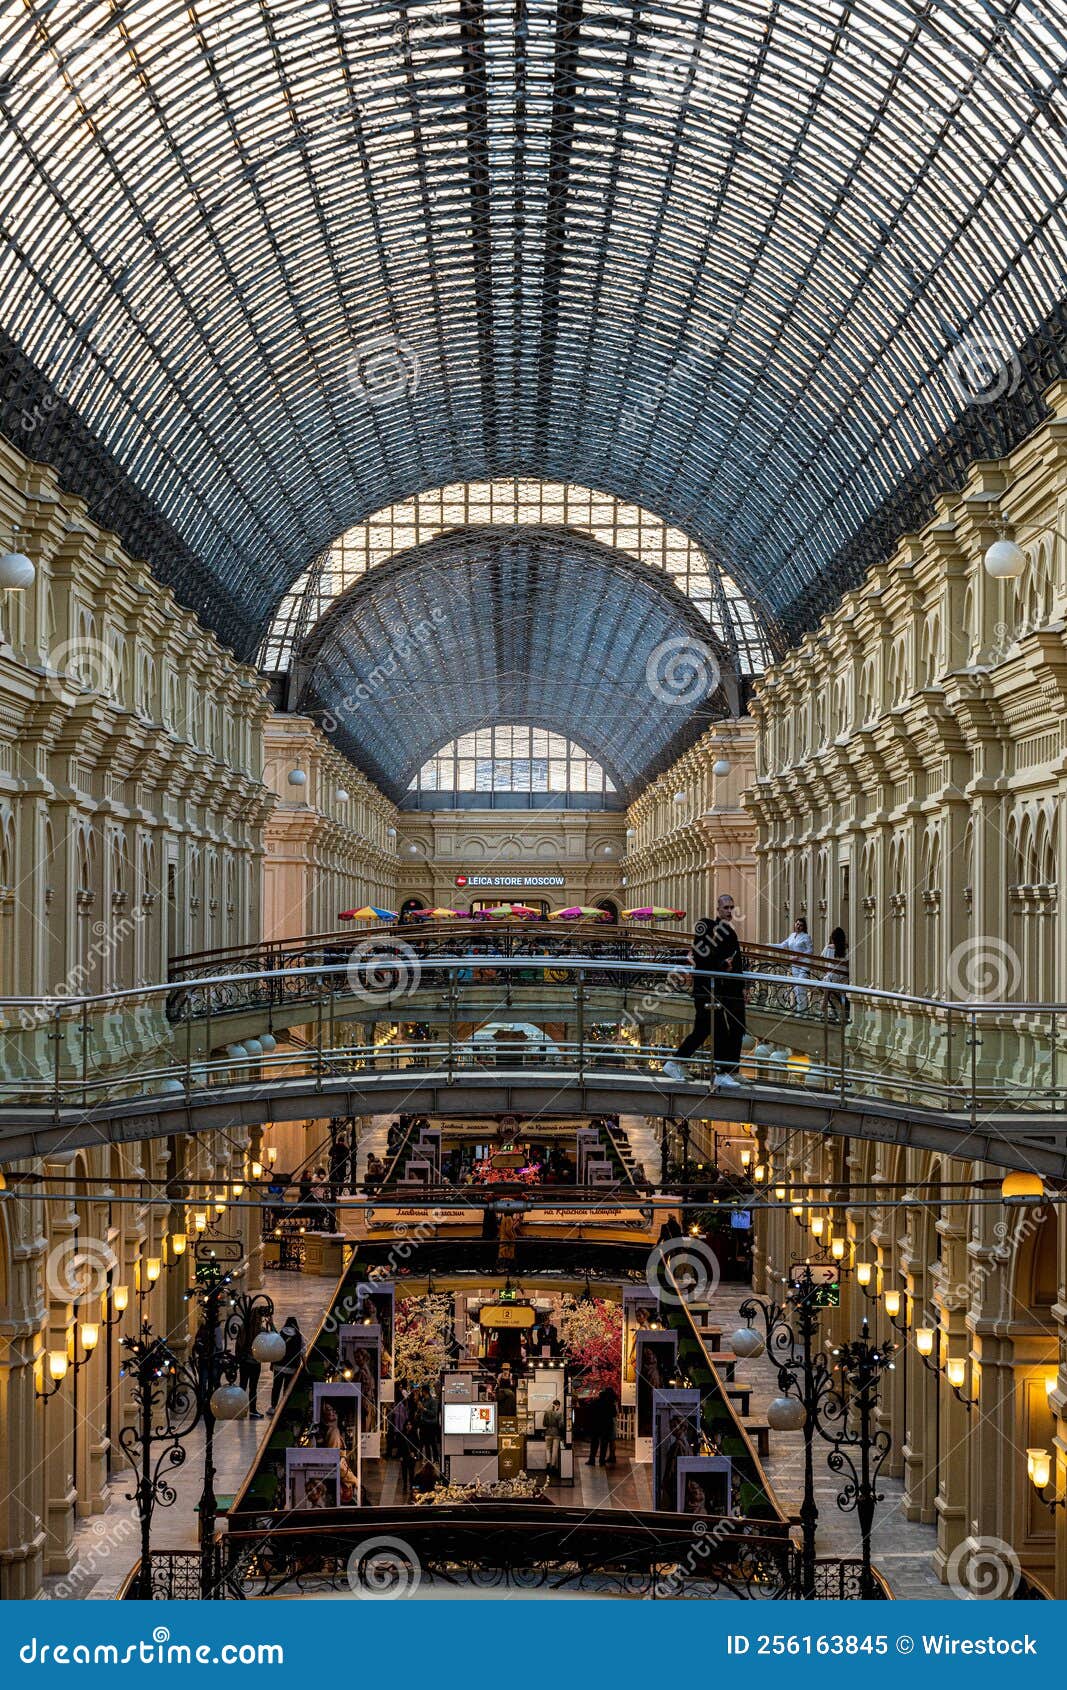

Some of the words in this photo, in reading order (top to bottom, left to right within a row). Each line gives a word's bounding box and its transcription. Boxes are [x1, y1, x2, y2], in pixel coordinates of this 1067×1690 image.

[468, 877, 492, 885] LEICA
[494, 877, 521, 885] STORE
[524, 877, 564, 885] MOSCOW
